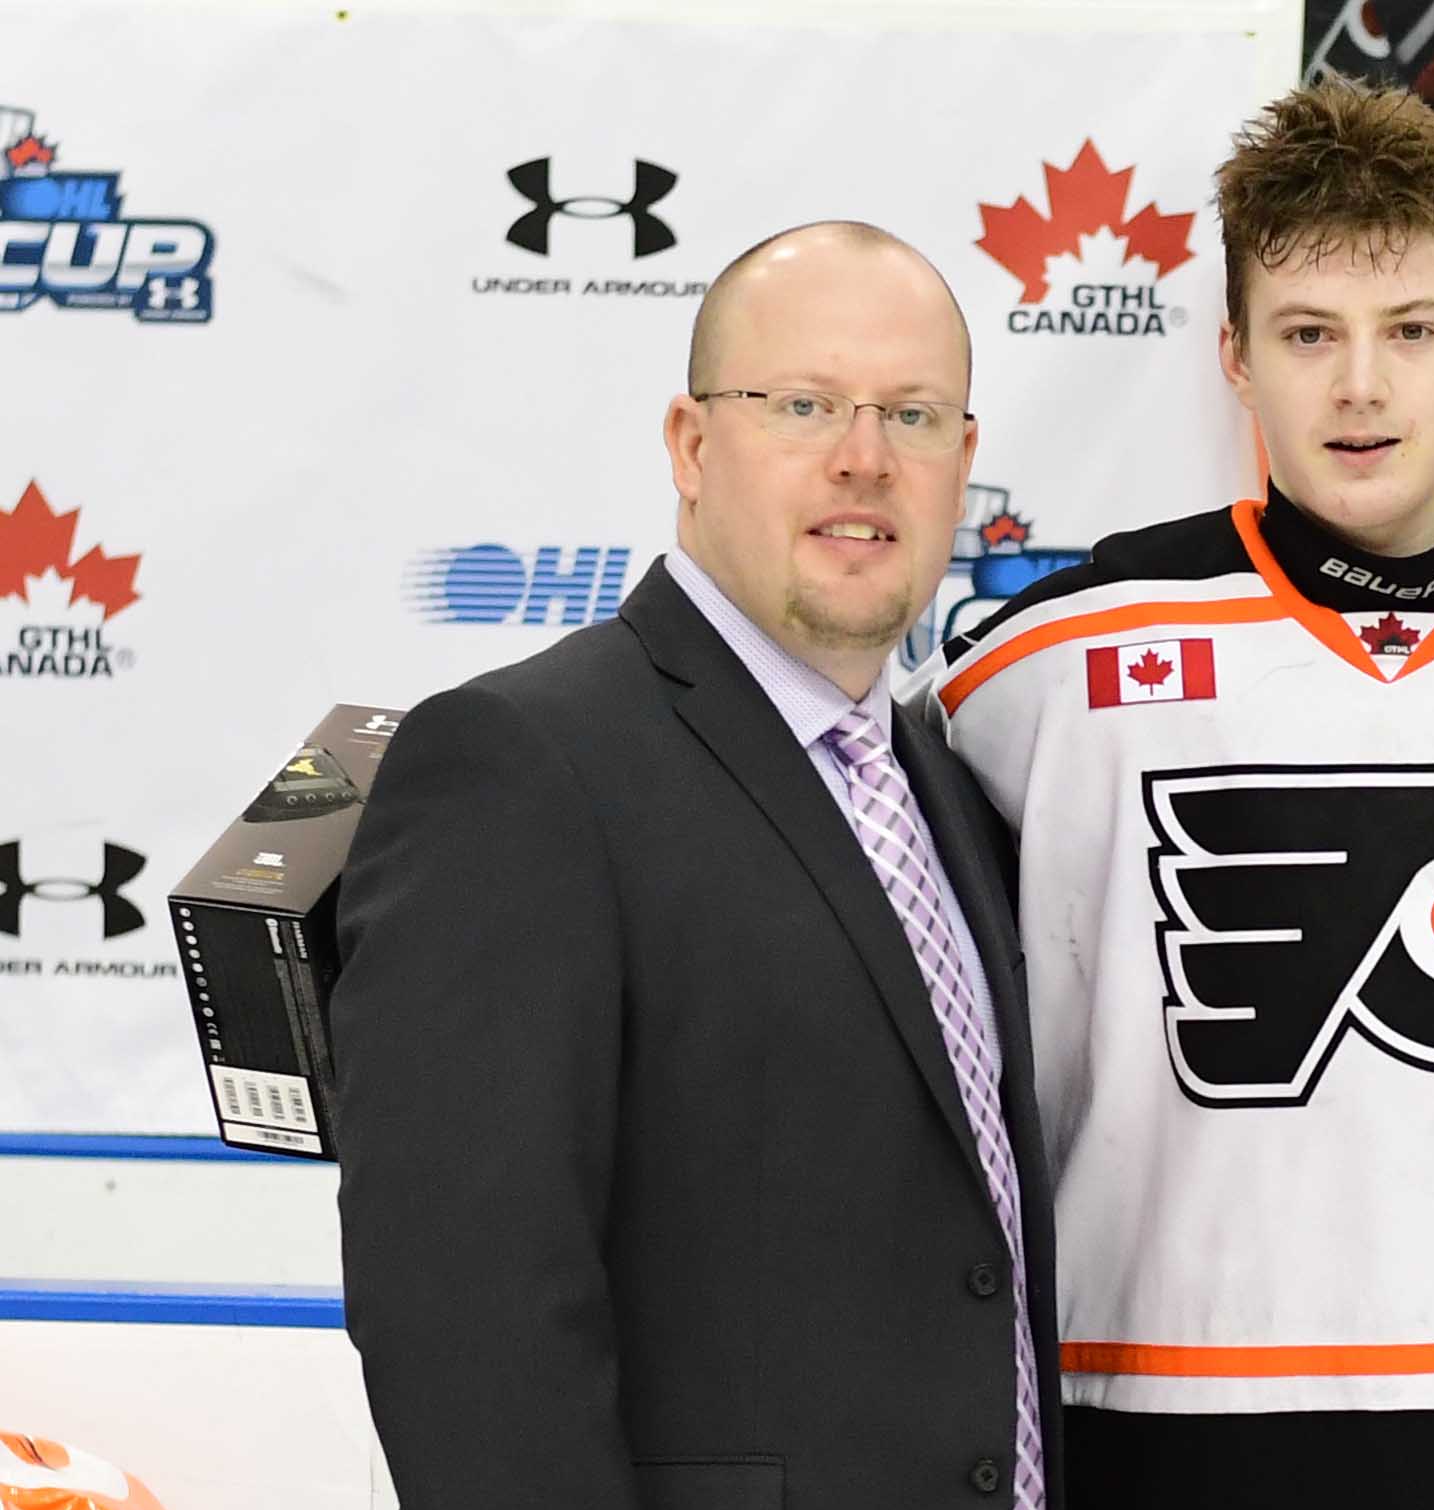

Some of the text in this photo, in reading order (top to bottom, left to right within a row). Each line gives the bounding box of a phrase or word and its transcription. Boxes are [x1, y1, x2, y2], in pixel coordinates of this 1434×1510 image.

[472, 278, 708, 297] UNDER ARMOUR
[1072, 284, 1165, 309] GTHL
[1008, 310, 1166, 337] CANADA
[19, 625, 113, 650] GTHL
[0, 652, 113, 677] NADA
[54, 961, 177, 978] ARMOUR
